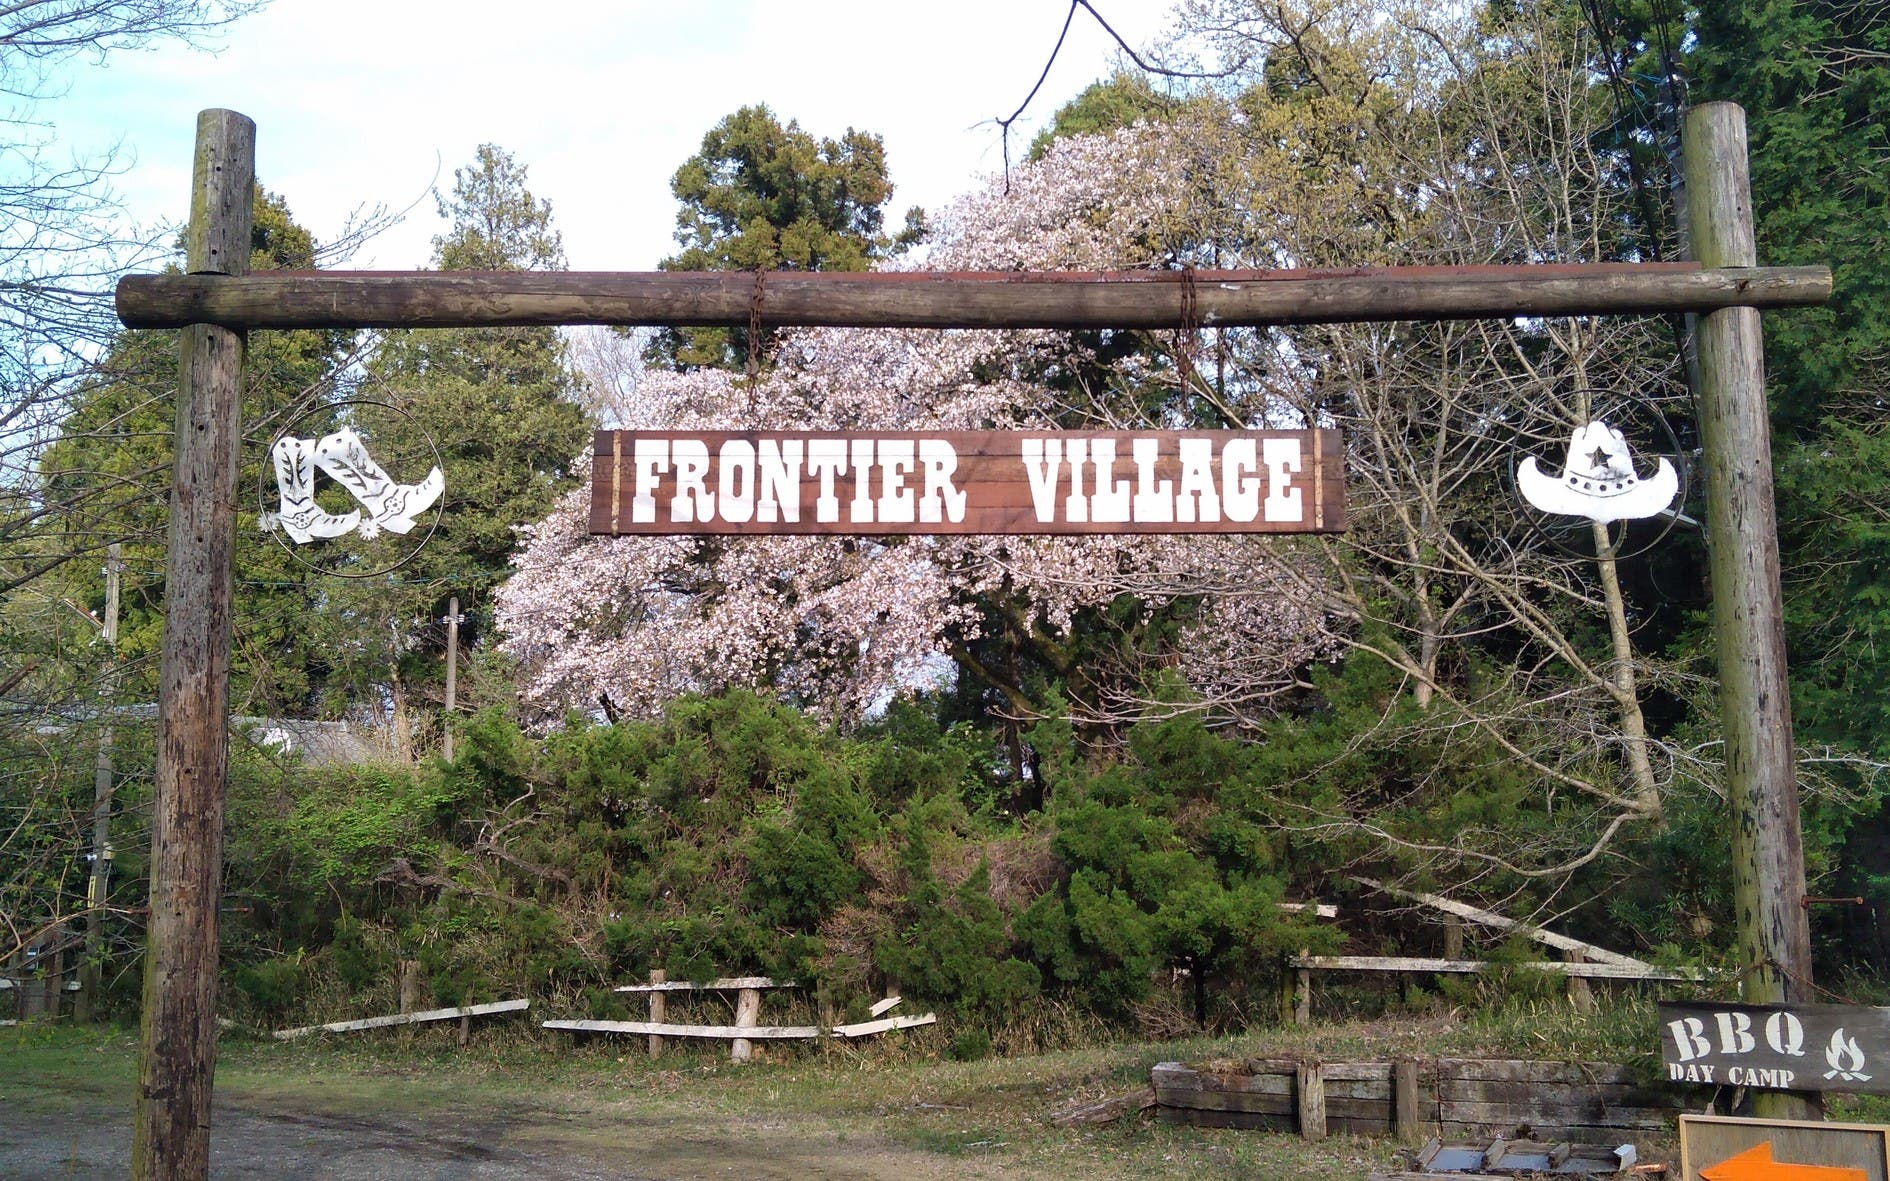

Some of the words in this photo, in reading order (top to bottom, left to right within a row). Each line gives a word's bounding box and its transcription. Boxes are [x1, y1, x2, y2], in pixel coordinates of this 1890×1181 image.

[632, 438, 967, 523] FRONTIER
[1020, 437, 1302, 523] VILLAGE
[1667, 1011, 1805, 1062] BBQ
[1669, 1062, 1715, 1083] DAY
[1728, 1066, 1795, 1088] CAMP
